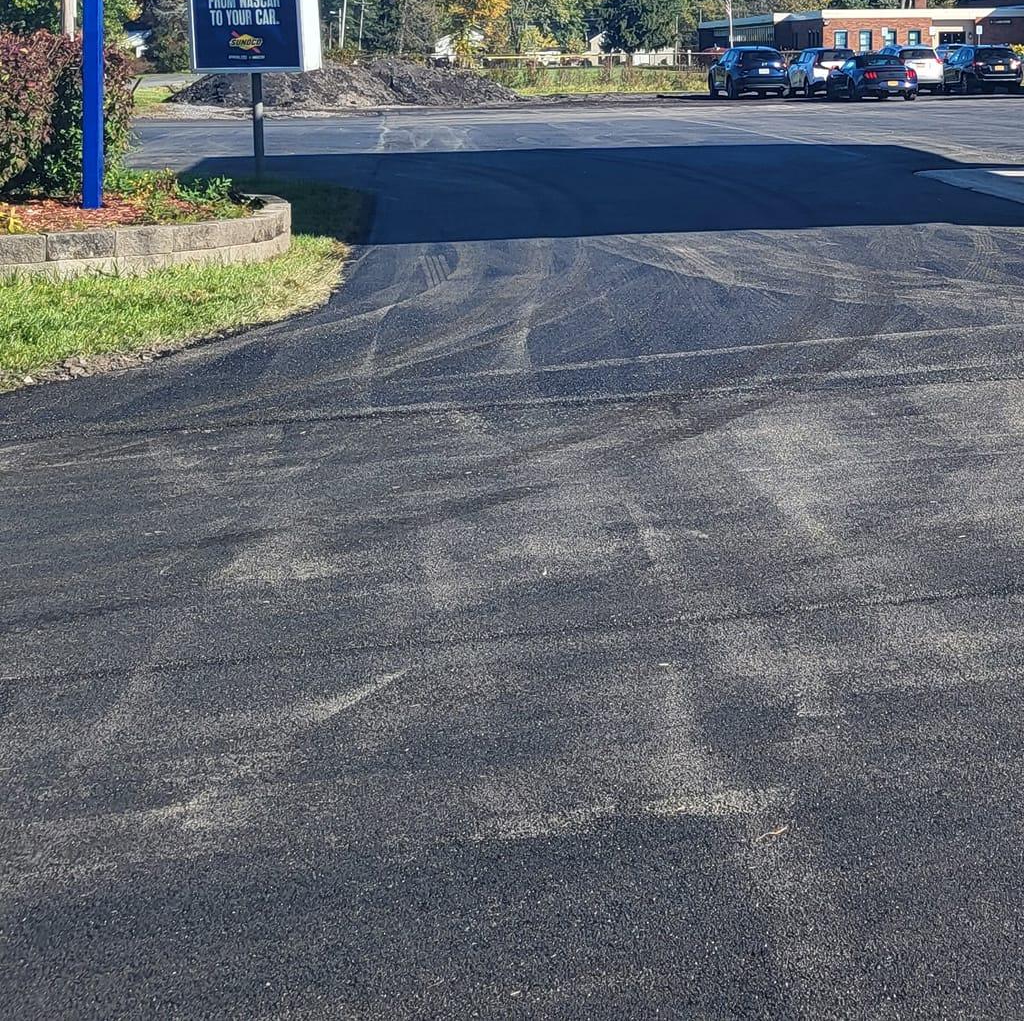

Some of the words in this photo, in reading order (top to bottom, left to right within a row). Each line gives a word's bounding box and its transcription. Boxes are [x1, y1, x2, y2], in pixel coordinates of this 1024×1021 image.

[209, 9, 223, 26] TO
[225, 9, 252, 26] YOUR
[255, 8, 280, 25] CAR.
[231, 38, 262, 46] SUNOCO
